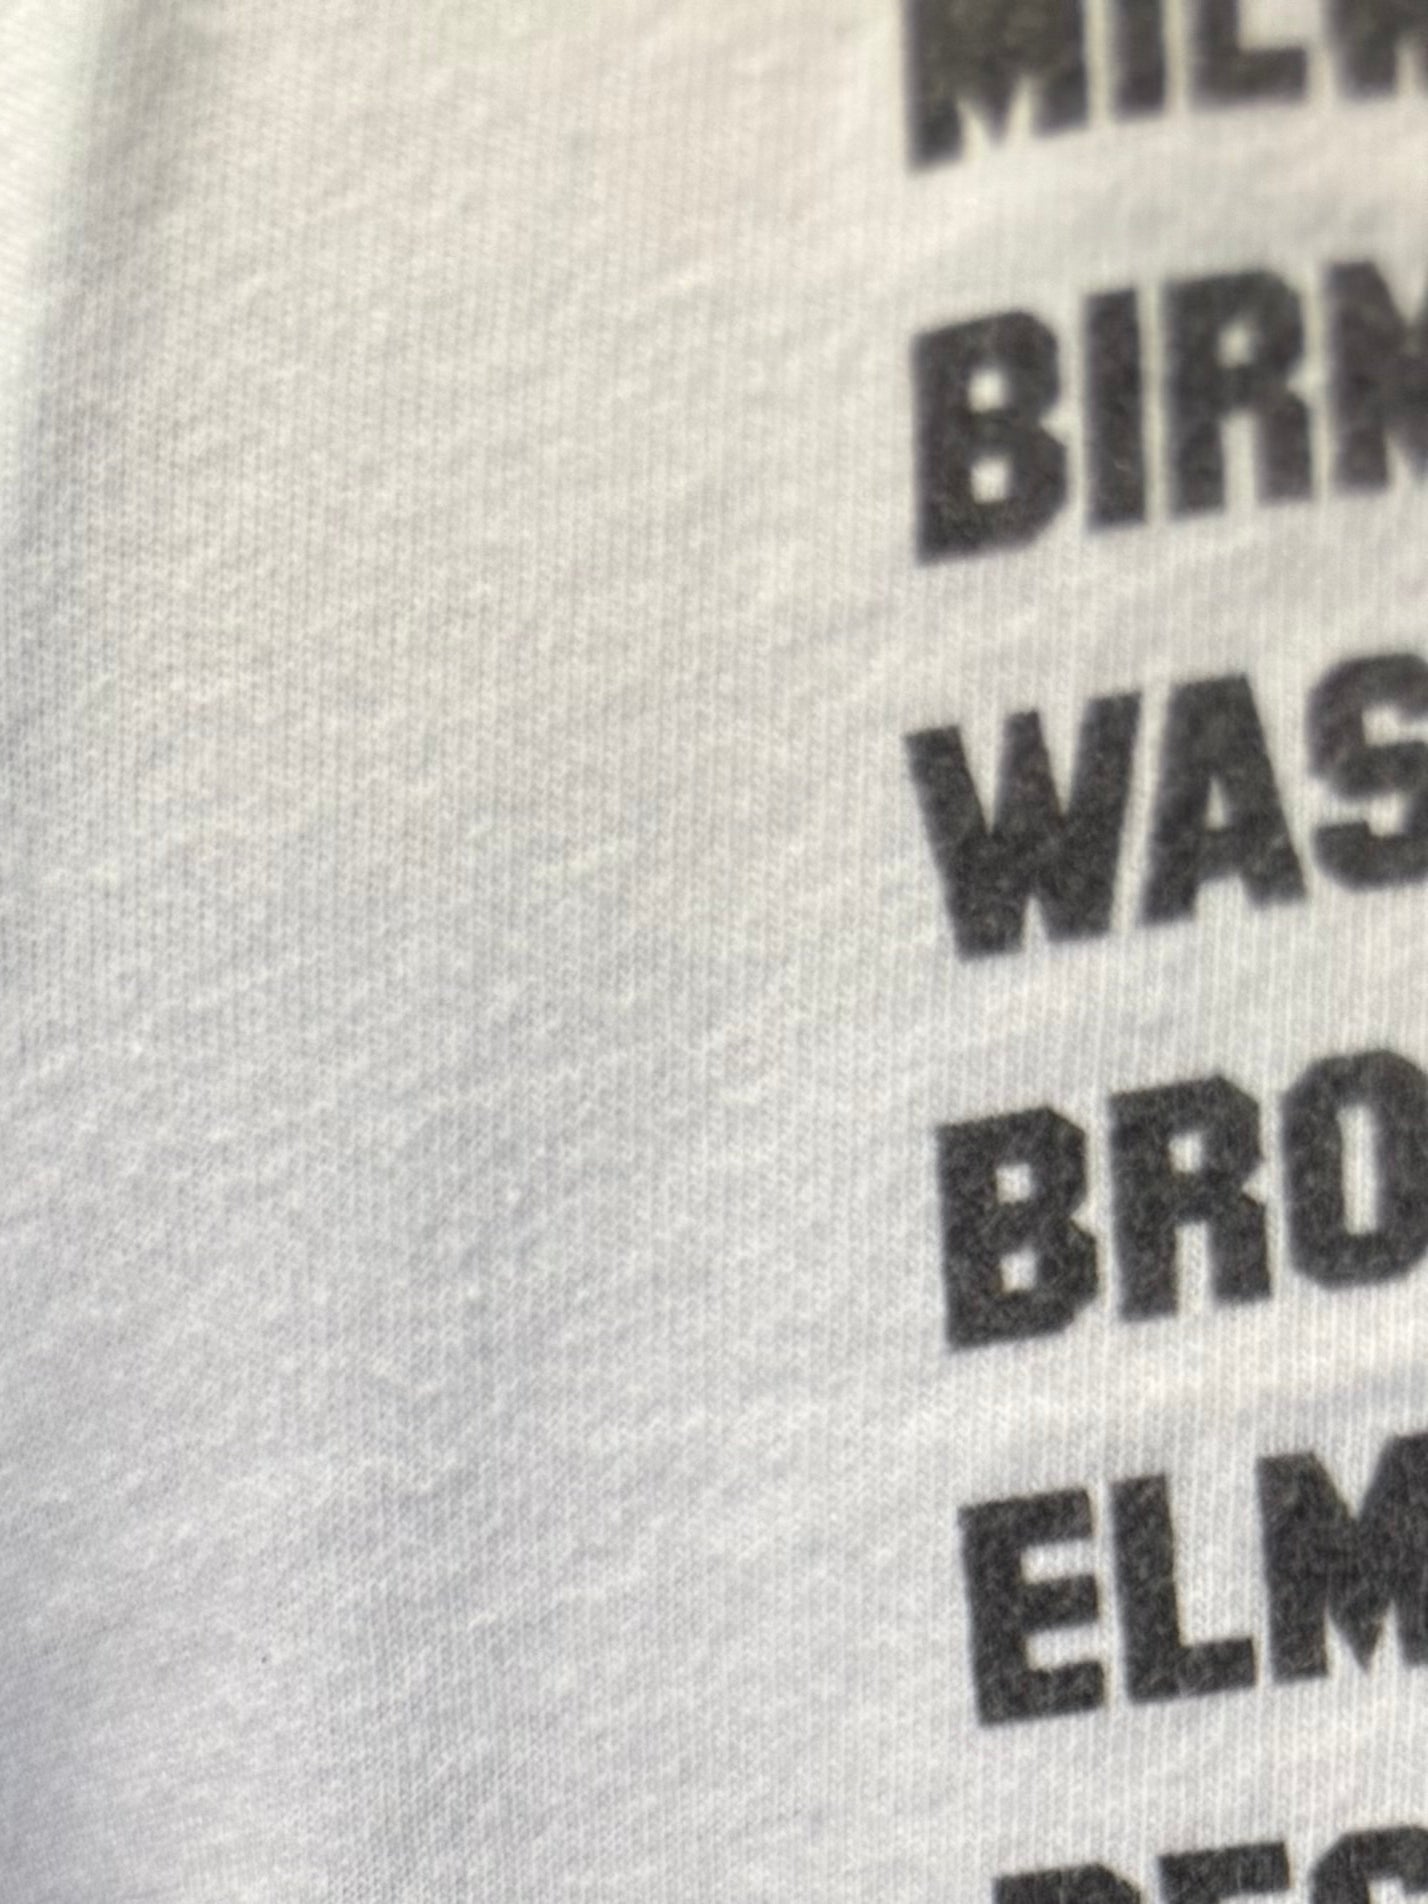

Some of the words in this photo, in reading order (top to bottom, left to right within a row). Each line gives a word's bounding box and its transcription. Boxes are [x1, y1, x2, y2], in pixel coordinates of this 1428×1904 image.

[903, 652, 1428, 961] WAS
[936, 1048, 1428, 1351] BRO
[957, 1430, 1428, 1728] ELM
